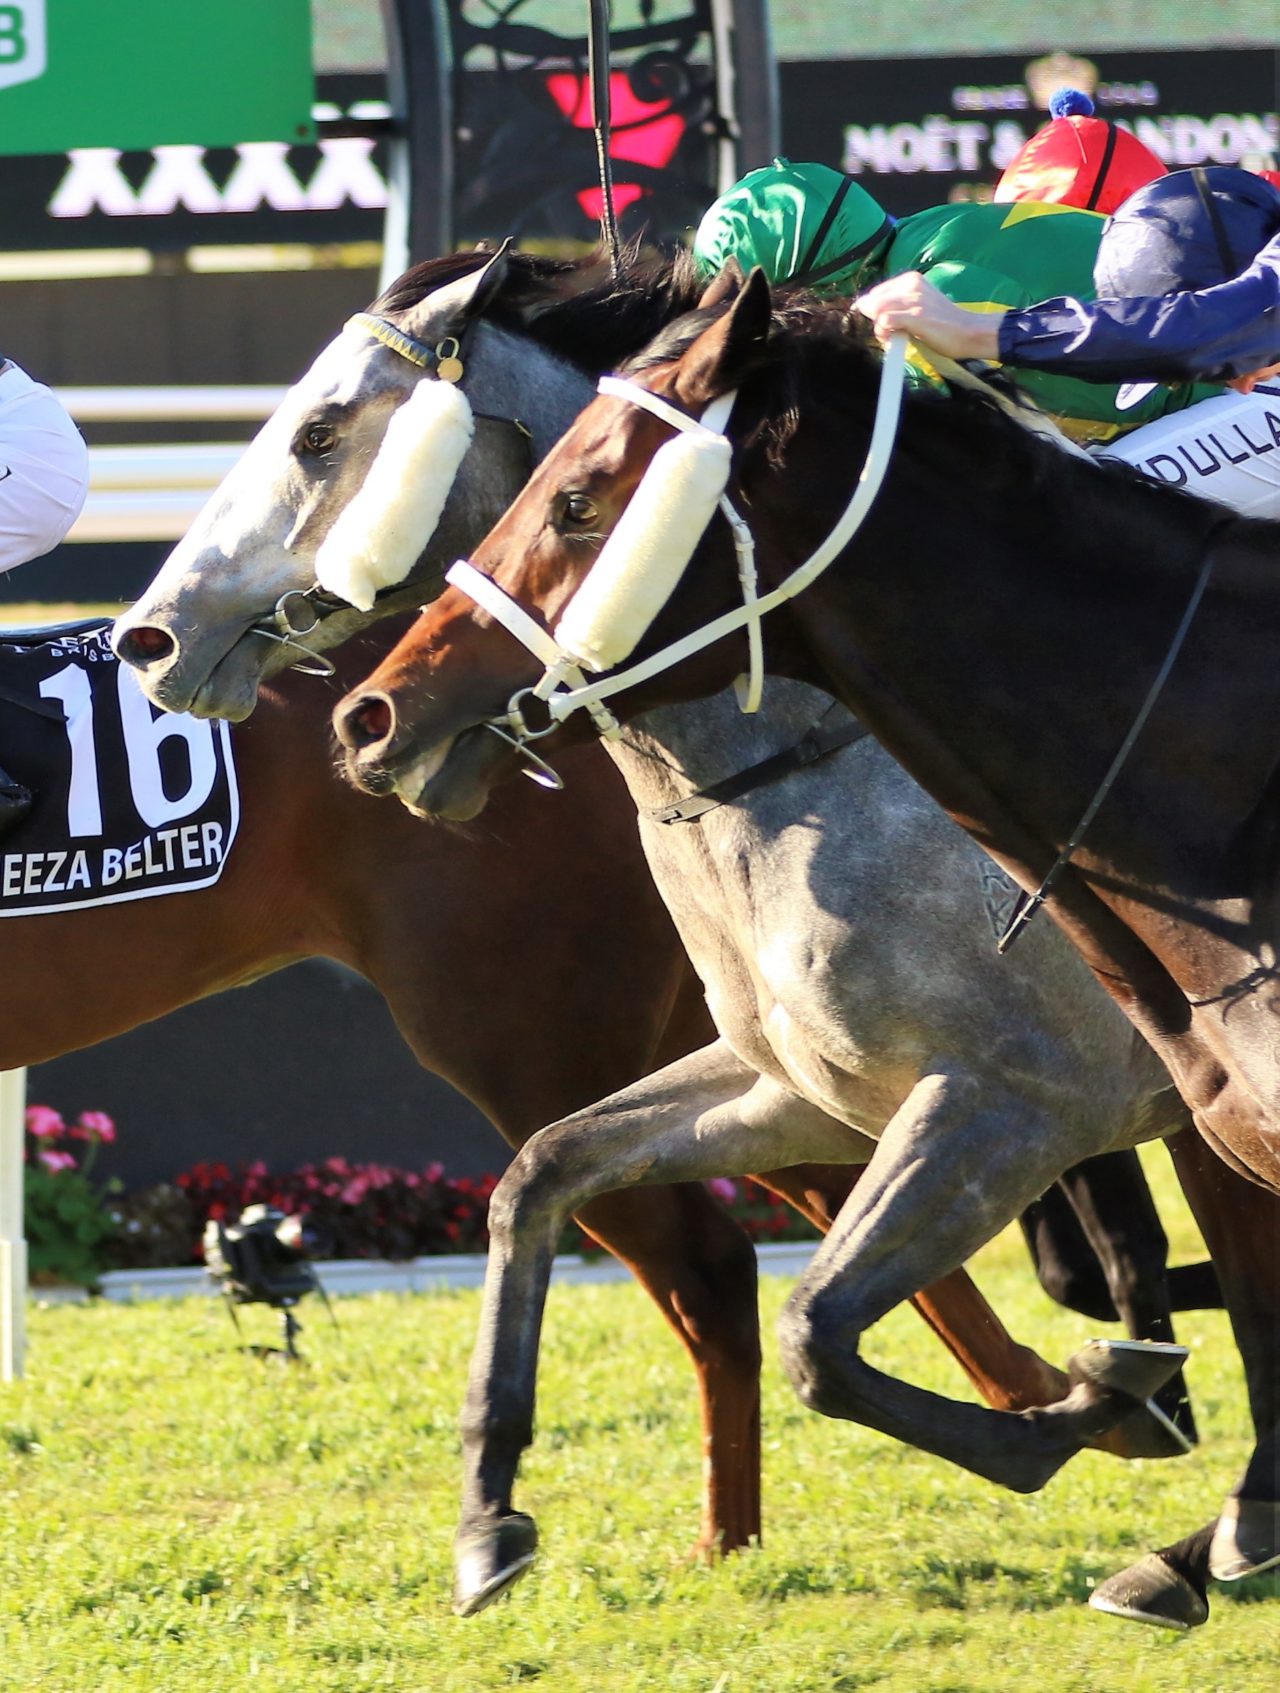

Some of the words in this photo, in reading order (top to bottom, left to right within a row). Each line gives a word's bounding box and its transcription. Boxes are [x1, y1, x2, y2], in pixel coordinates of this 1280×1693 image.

[1135, 411, 1280, 486] DULLA
[38, 658, 217, 837] 16
[101, 821, 223, 886] BELTER
